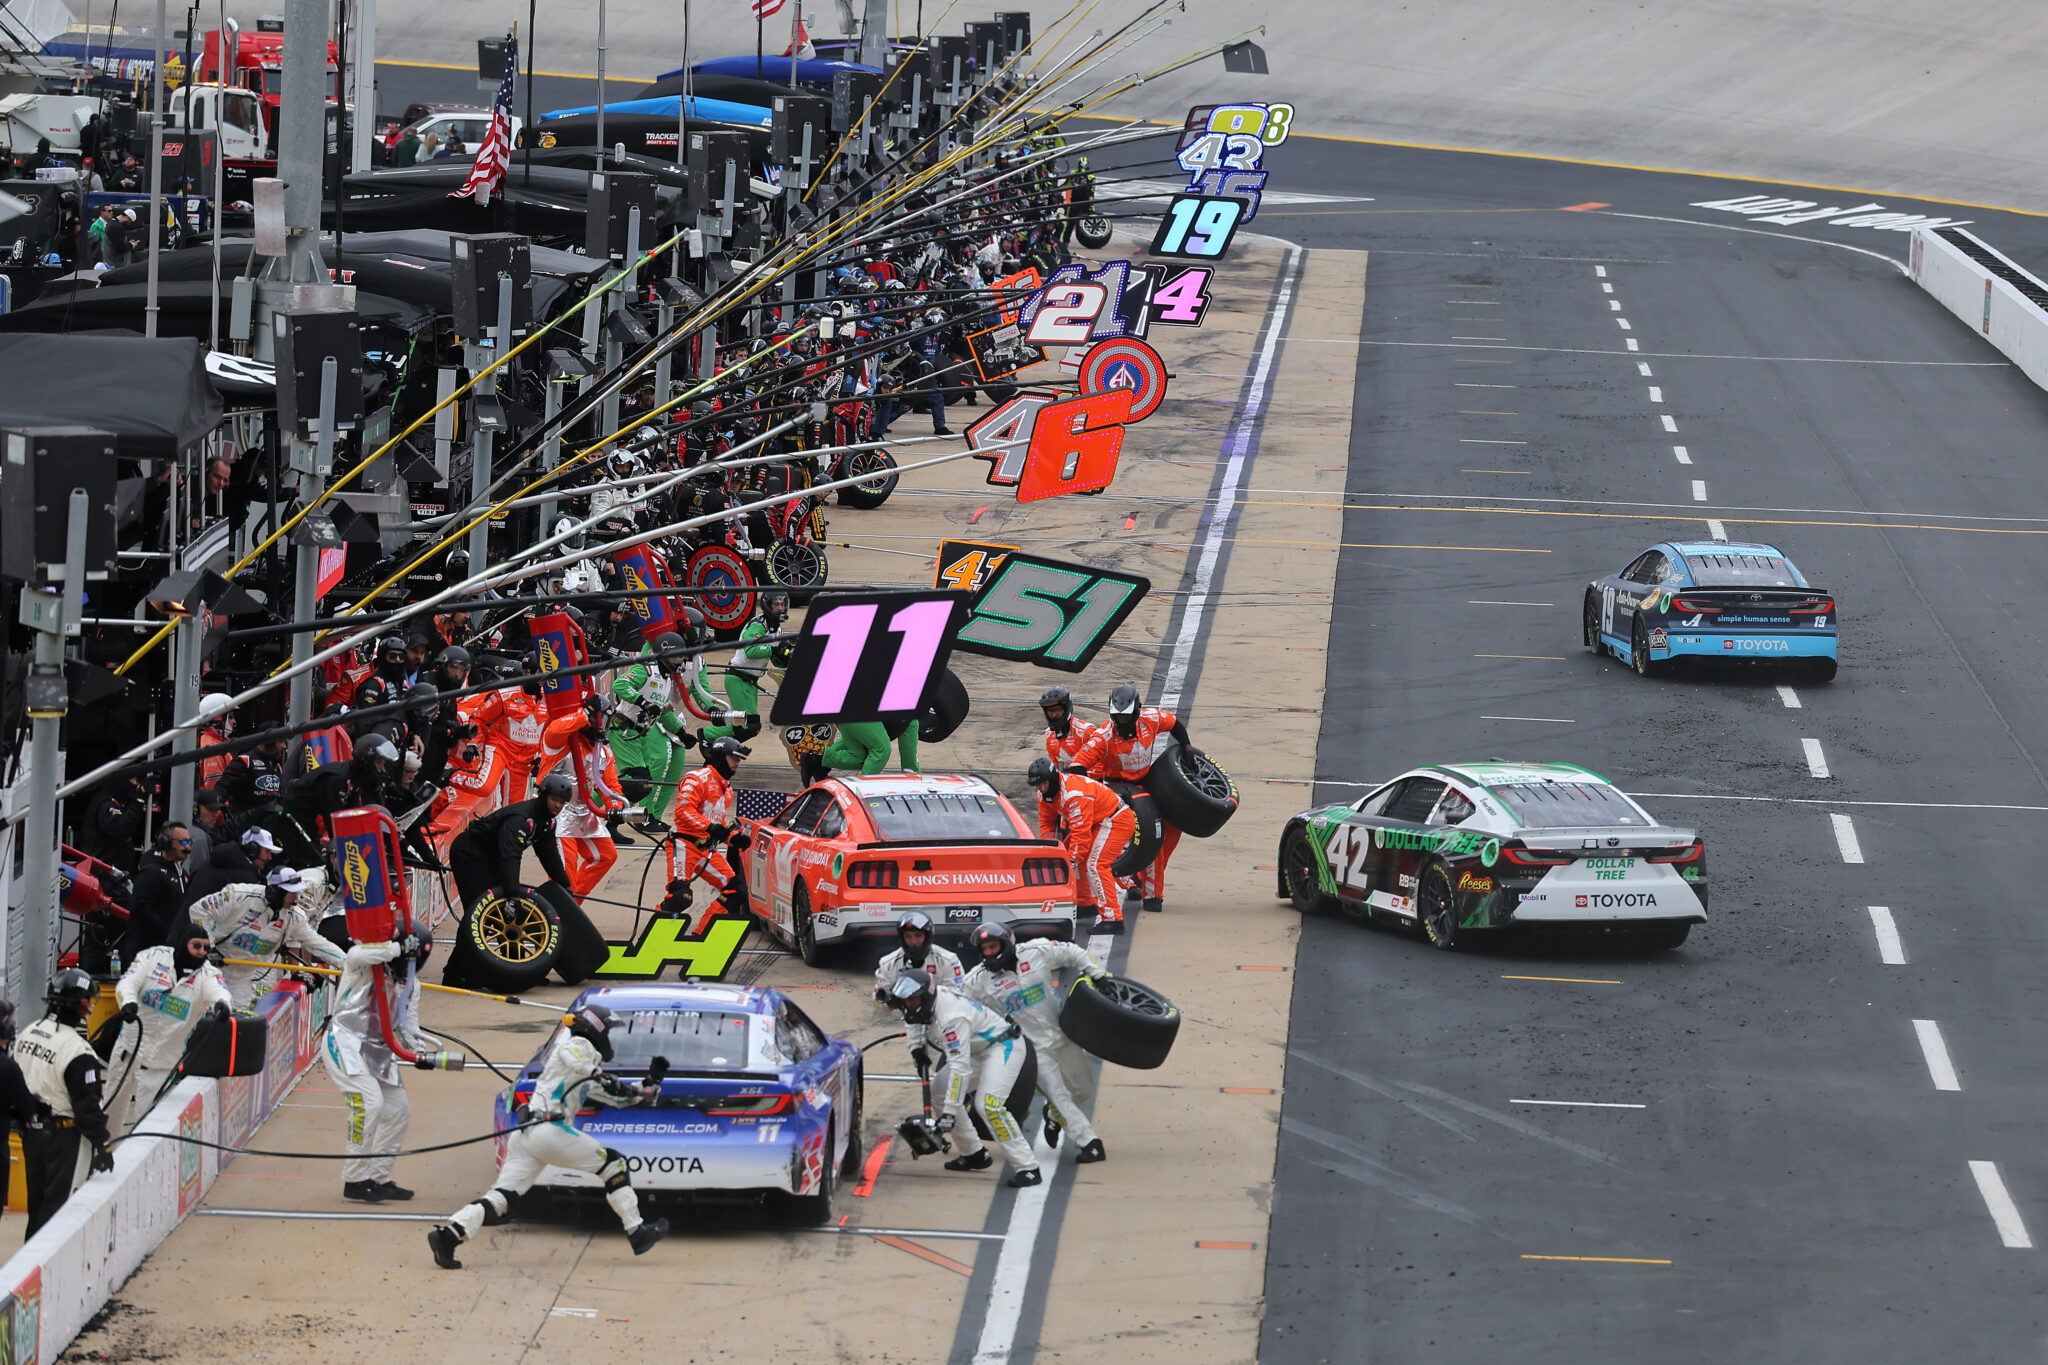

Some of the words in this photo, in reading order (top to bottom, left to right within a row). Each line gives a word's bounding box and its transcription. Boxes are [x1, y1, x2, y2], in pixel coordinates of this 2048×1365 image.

[645, 132, 679, 140] TRACKER
[1160, 198, 1241, 256] 19
[1026, 284, 1107, 342] 2
[1020, 388, 1133, 504] 6
[410, 503, 445, 512] DISCOUNT
[768, 540, 780, 584] GOODYEAR
[818, 556, 826, 578] EAGLE
[957, 560, 1138, 663] 51
[1602, 585, 1616, 636] 19
[1717, 614, 1742, 624] simple
[1743, 614, 1769, 623] human
[1770, 615, 1791, 624] sense
[1813, 615, 1827, 628] 19
[1677, 636, 1696, 644] Mobil
[1735, 638, 1790, 651] TOYOTA
[538, 637, 559, 690] SUNOO
[801, 599, 955, 716] 11
[785, 729, 803, 740] 42
[1384, 827, 1440, 851] DOLLAR
[1437, 831, 1483, 855] TREE
[1326, 823, 1370, 889] 42
[1586, 858, 1635, 869] DOLLAR
[344, 840, 367, 905] SUNOCO
[908, 872, 950, 887] KING'S
[952, 872, 1017, 886] HAWAIIAN
[1459, 871, 1492, 892] Reese's
[1595, 869, 1626, 880] TREE
[1682, 866, 1699, 881] 42
[1039, 900, 1057, 913] 6
[1590, 893, 1657, 907] TOYOTA
[470, 893, 496, 951] GOODYEAR
[817, 913, 839, 928] EDGE
[948, 908, 980, 919] FORD
[546, 924, 559, 956] EAGLE
[17, 1040, 57, 1065] OFFICIAL
[739, 1086, 765, 1095] XSE
[351, 1092, 366, 1146] MAVIS
[582, 1122, 719, 1134] EXPRESSOIL.COM
[984, 1092, 1011, 1143] MAVIS
[757, 1123, 782, 1144] 11
